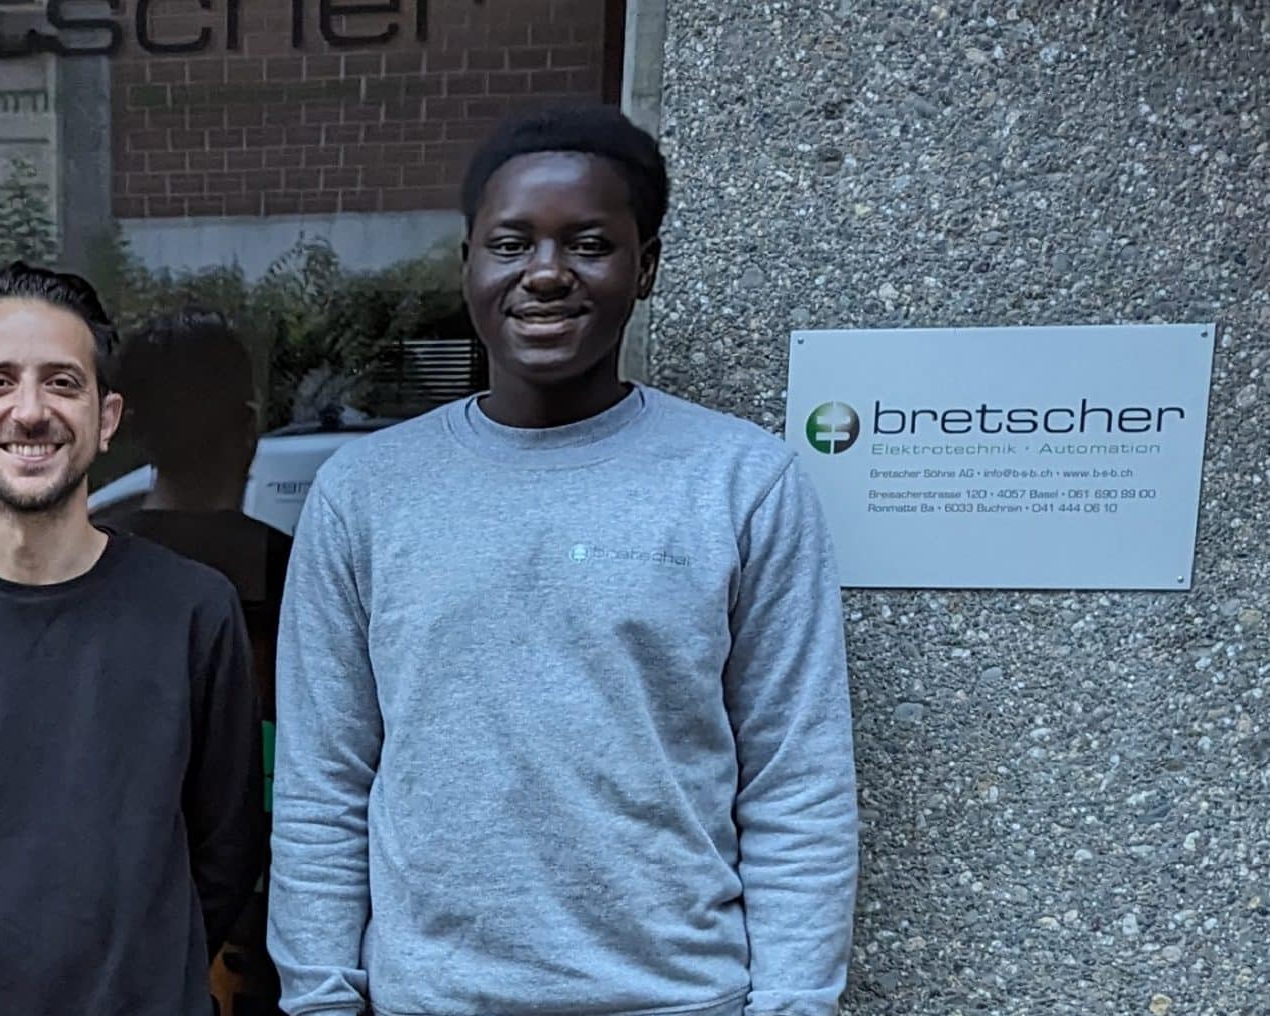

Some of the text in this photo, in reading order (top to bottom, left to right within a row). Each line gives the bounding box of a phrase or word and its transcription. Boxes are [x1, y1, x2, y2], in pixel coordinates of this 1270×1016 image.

[873, 398, 1186, 434] bretscher
[871, 442, 1162, 456] Elektrotechnik Automation
[869, 468, 922, 479] Bretscher
[958, 468, 975, 479] AG
[966, 489, 988, 500] 120
[997, 489, 1027, 499] 4057
[1029, 489, 1059, 499] Basel
[1067, 489, 1090, 499] 061
[867, 503, 918, 513] Ronmatte
[944, 503, 974, 513] 6033
[1031, 503, 1054, 513] 041
[1058, 503, 1081, 513] 444
